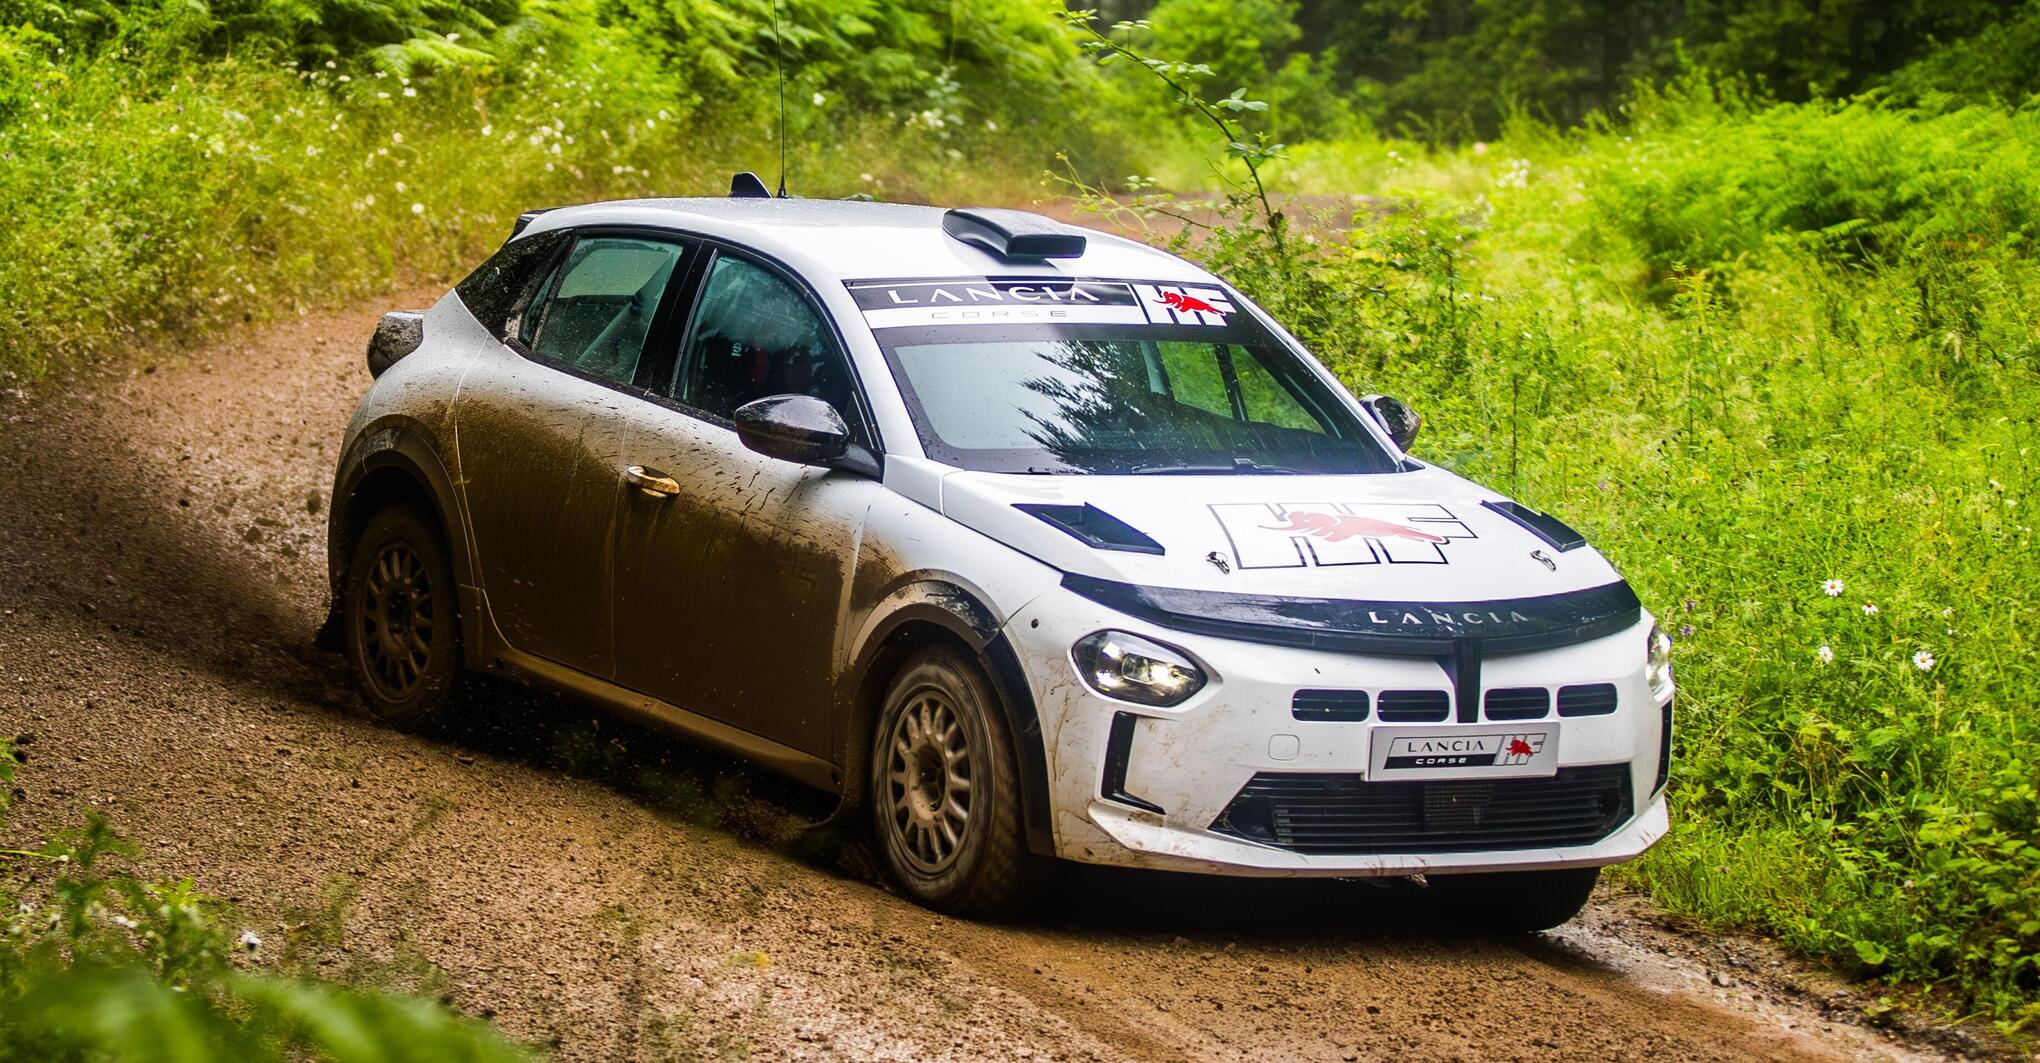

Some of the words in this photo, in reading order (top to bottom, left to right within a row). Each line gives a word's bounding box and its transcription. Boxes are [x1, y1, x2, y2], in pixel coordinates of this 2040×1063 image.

[887, 286, 1101, 304] LANCIA
[931, 310, 1067, 319] CORSE
[1368, 610, 1529, 625] LANCIA
[1407, 740, 1485, 753] LANCIA
[1415, 757, 1468, 765] CORSE
